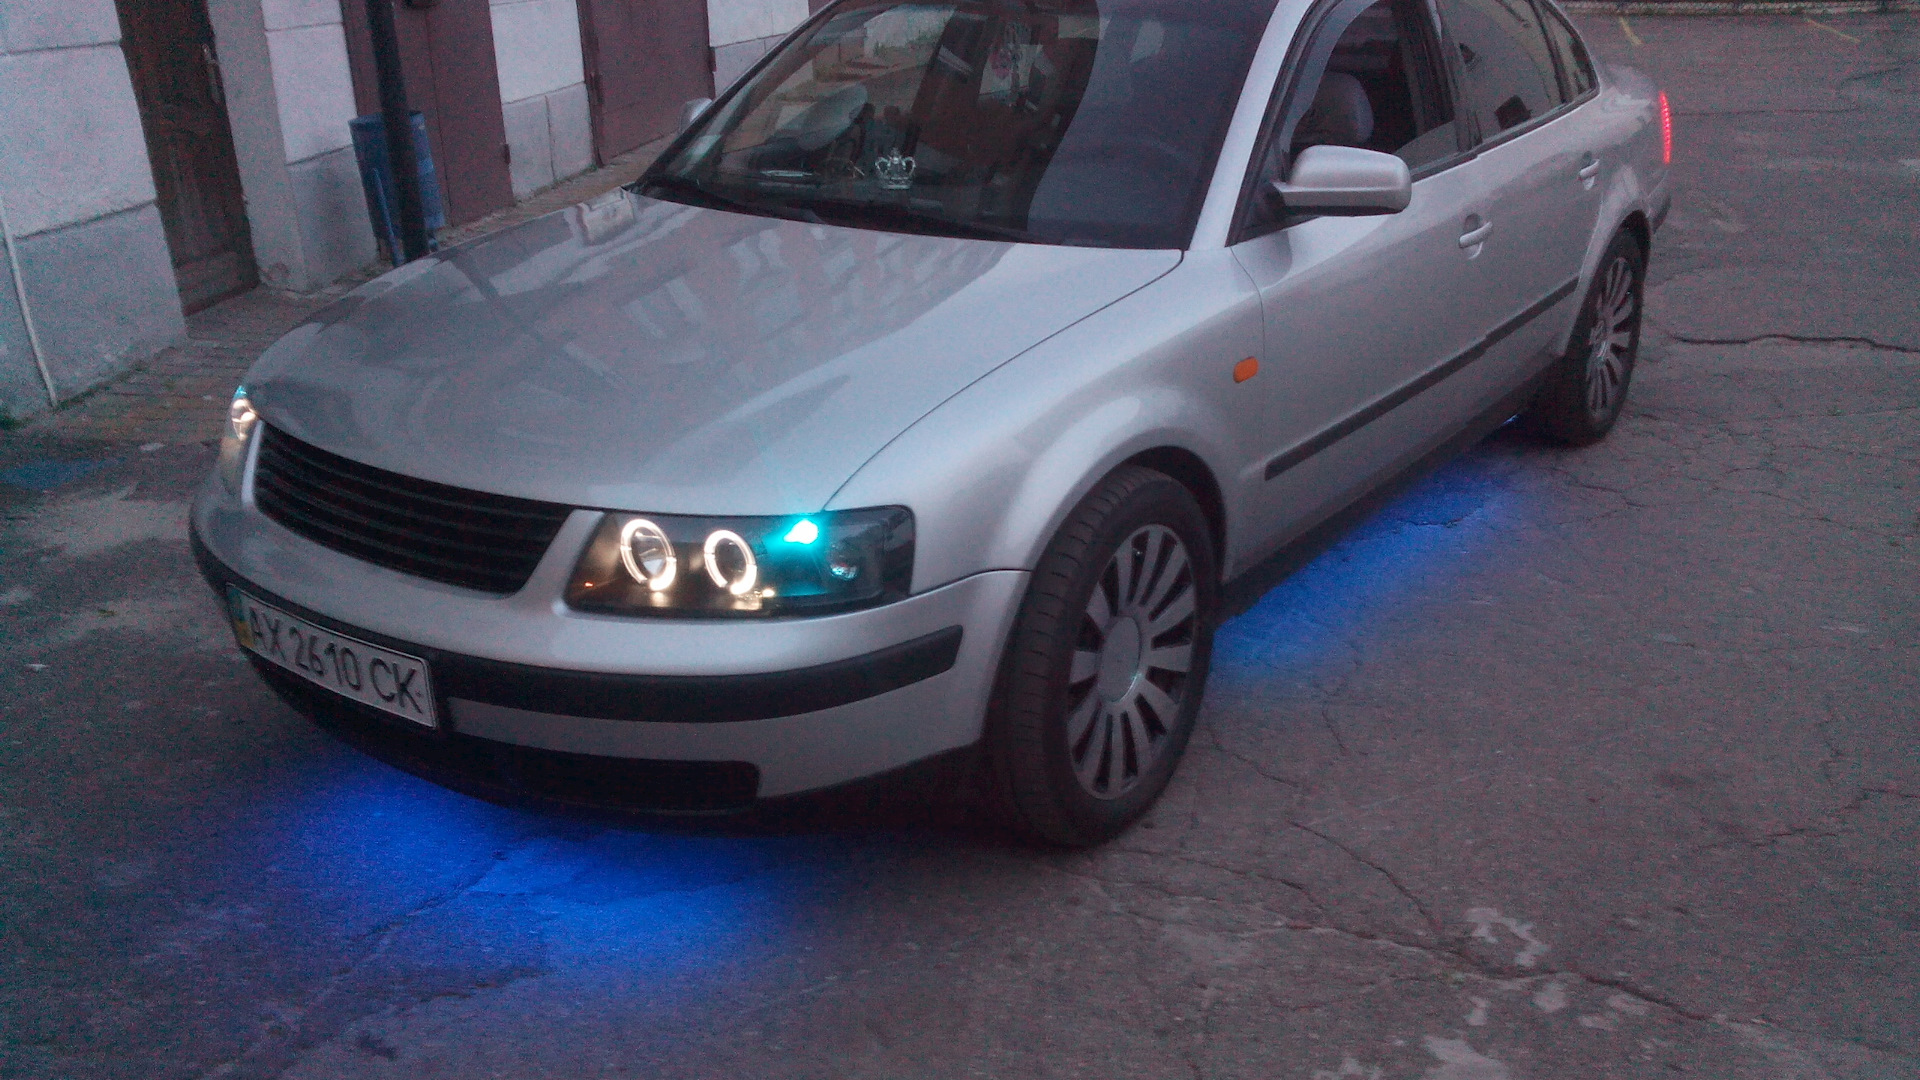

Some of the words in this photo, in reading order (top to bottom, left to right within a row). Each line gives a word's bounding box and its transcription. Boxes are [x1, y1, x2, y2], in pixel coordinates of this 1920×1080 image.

[249, 606, 286, 662] AX
[289, 626, 361, 691] 2610
[369, 657, 423, 715] CK
